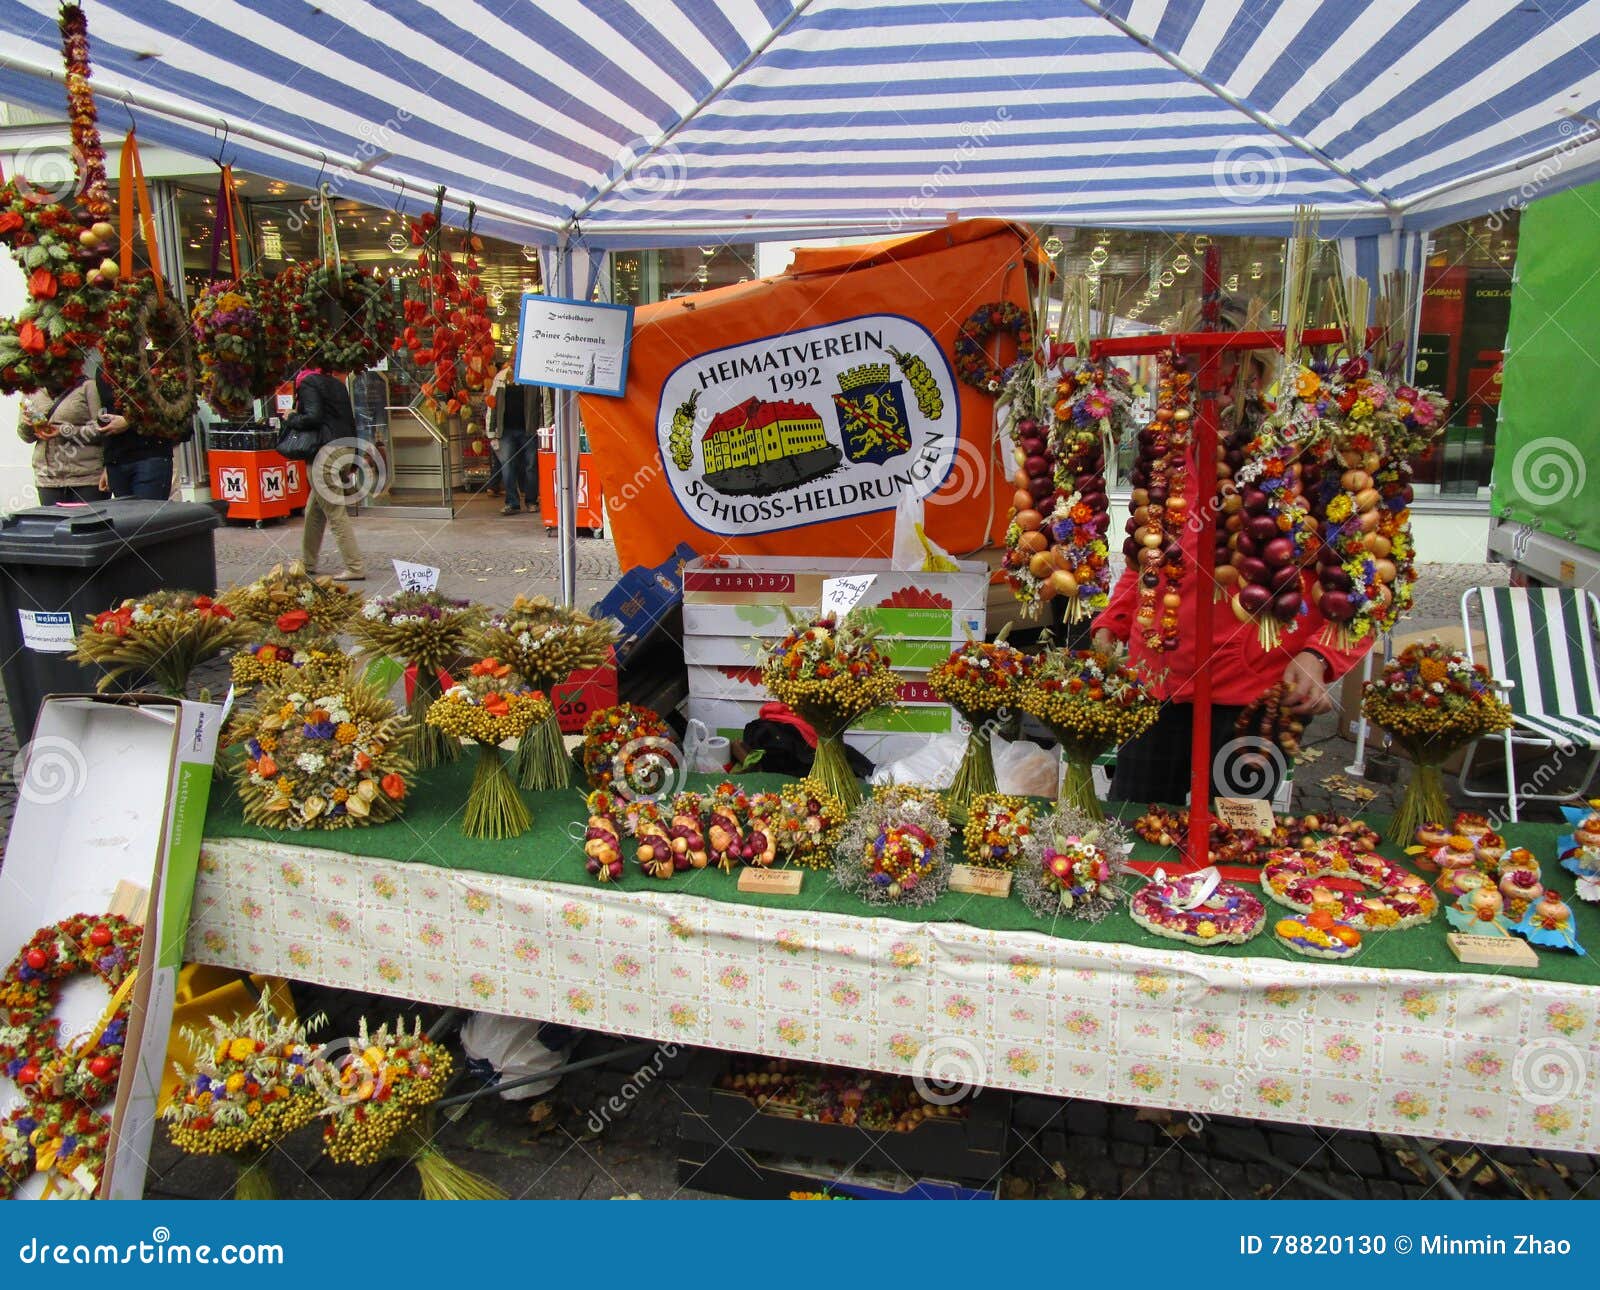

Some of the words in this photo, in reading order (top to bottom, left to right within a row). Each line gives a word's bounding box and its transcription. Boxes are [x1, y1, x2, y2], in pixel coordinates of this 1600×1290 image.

[532, 330, 560, 339] Rainer
[698, 330, 884, 389] HEIMATVEREIN
[768, 367, 822, 393] 1992
[226, 477, 241, 492] M
[266, 476, 280, 492] M
[685, 431, 945, 523] SCHLOSS-HELDRUNGEN
[715, 575, 790, 591] Gerbera
[836, 579, 868, 592] Strauß
[36, 614, 67, 622] weimar
[174, 769, 192, 846] Anthurium
